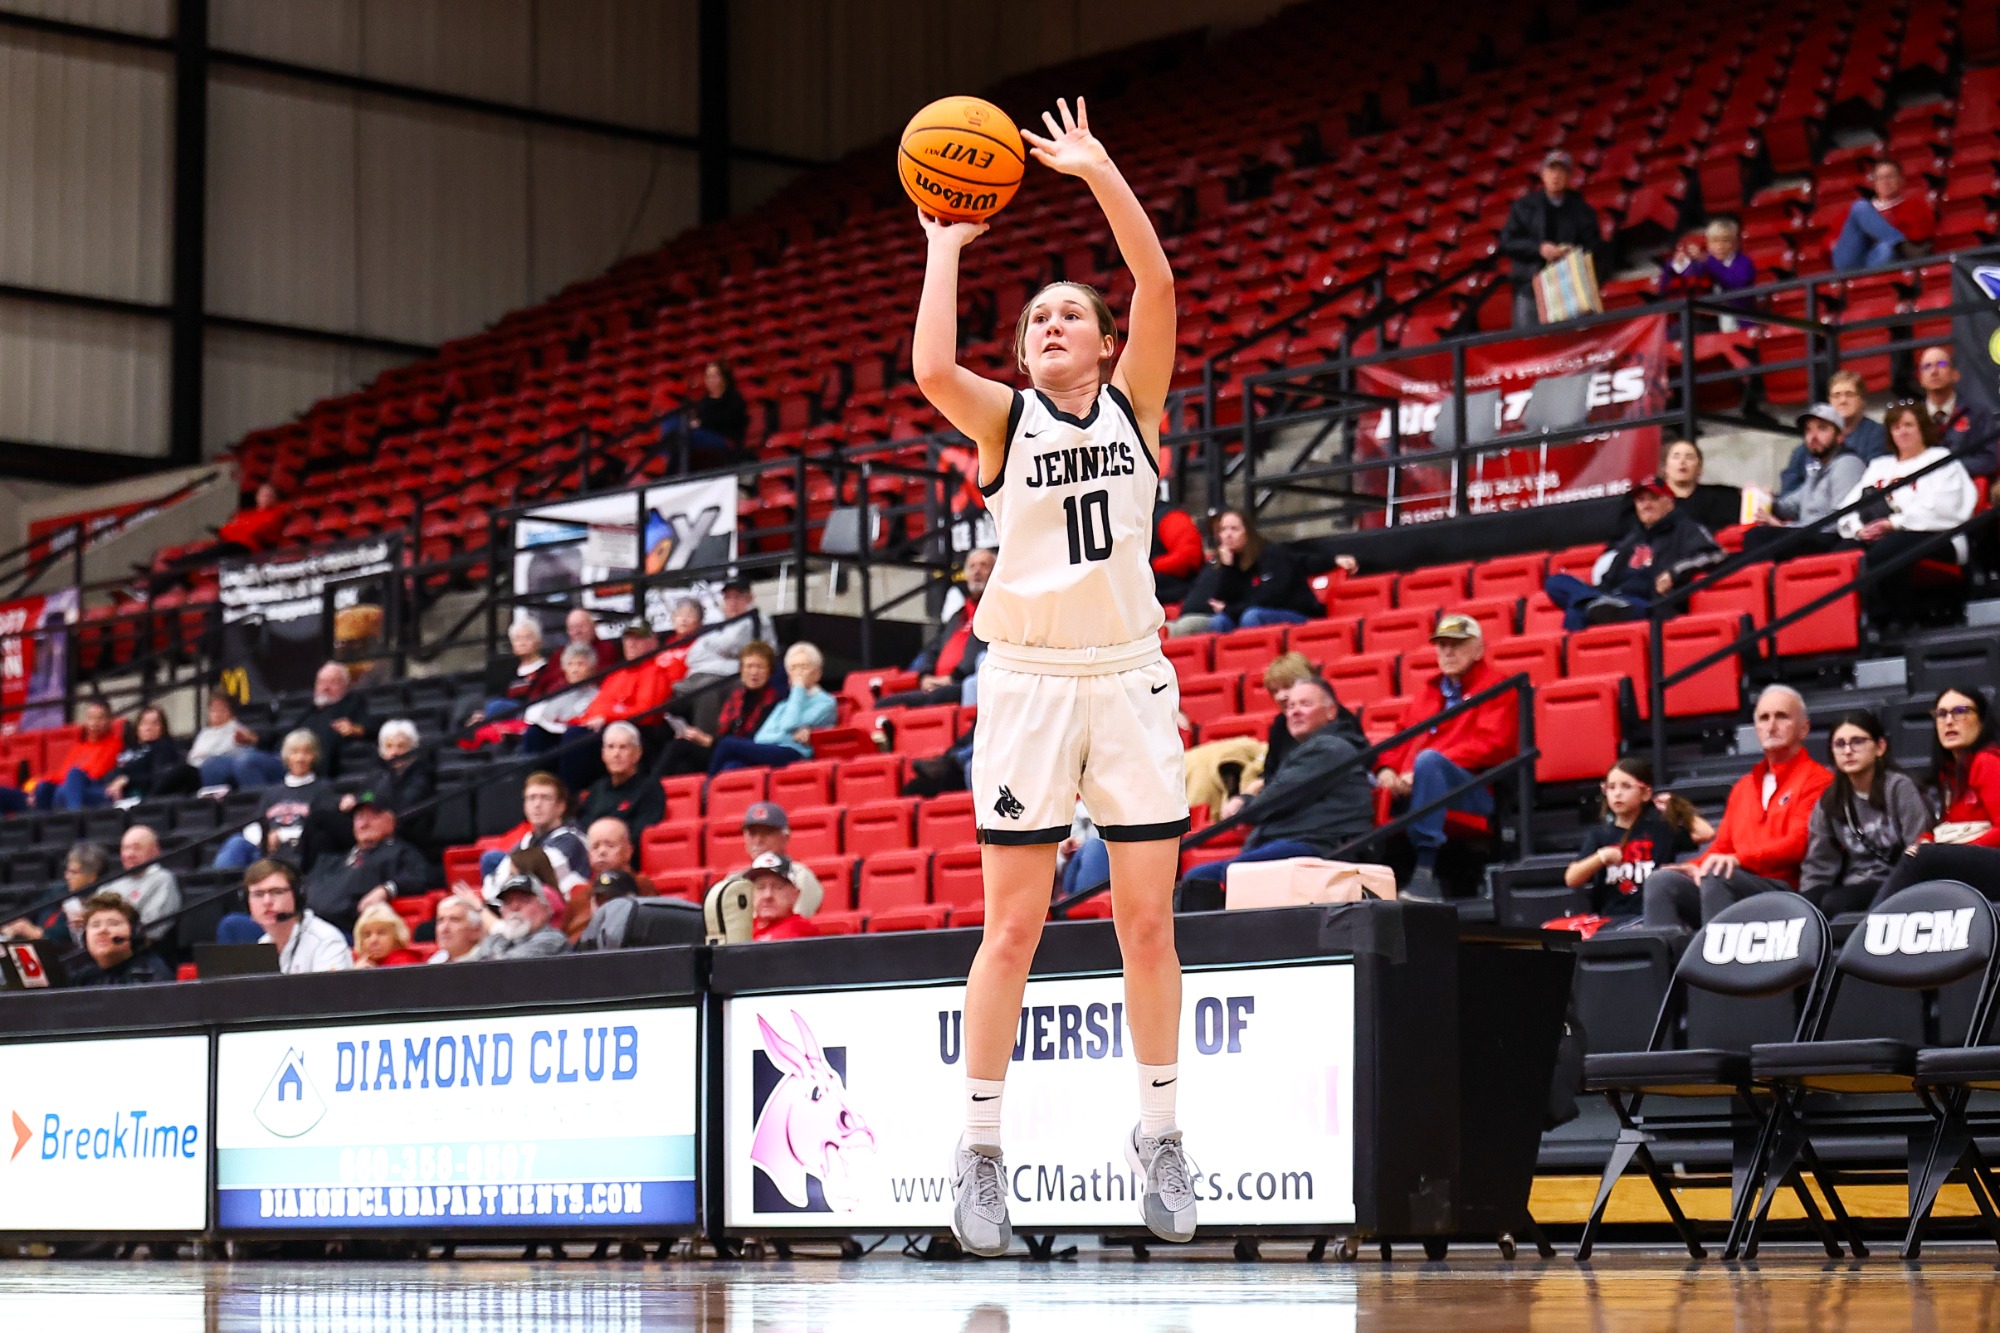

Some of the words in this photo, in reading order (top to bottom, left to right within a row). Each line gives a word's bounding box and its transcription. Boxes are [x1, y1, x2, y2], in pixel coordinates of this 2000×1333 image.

[915, 170, 997, 211] Wilson
[1026, 441, 1135, 488] JENNIES
[1063, 489, 1114, 565] 10
[1702, 918, 1807, 965] UCM
[1863, 908, 1976, 956] UCM
[1195, 996, 1255, 1056] OF
[336, 1032, 513, 1092] DIAMOND
[530, 1025, 638, 1084] CLUB
[41, 1110, 198, 1160] BreakTime
